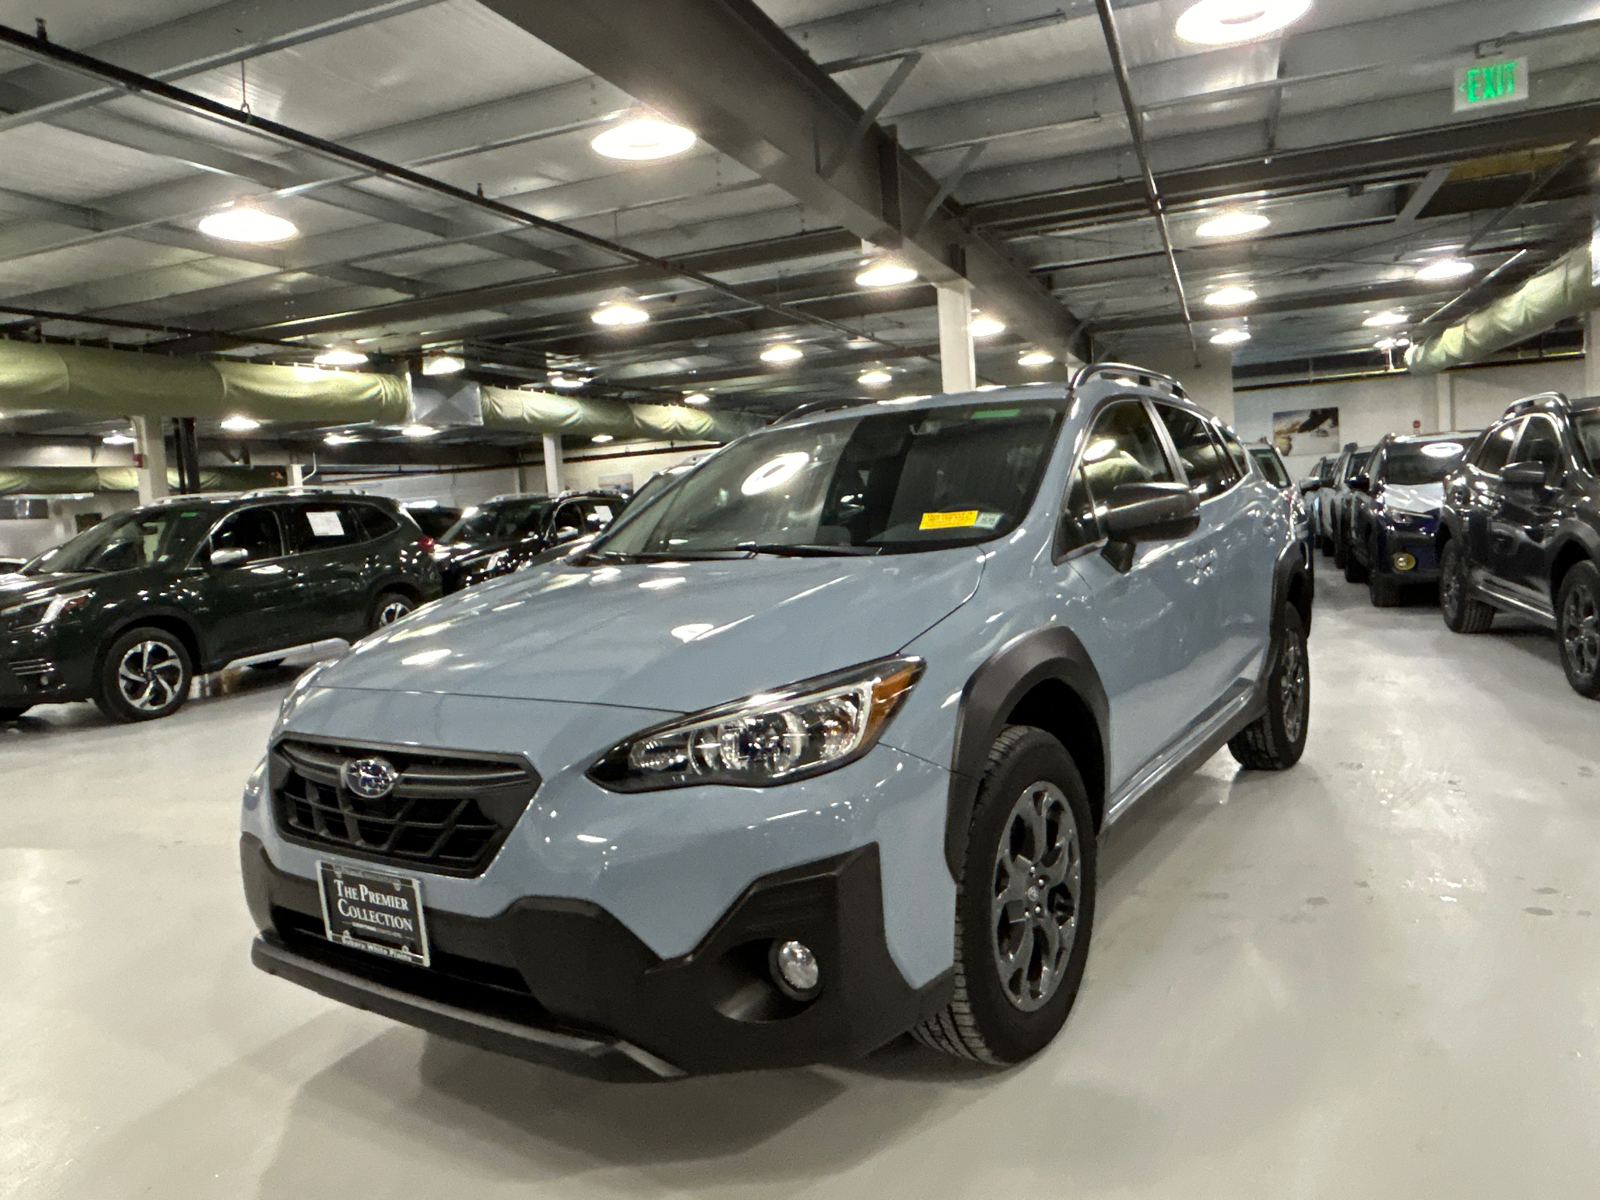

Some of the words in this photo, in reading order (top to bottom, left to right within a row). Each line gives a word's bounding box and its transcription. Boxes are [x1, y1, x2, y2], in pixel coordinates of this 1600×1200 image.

[1467, 61, 1517, 103] EXIT
[333, 879, 359, 901] THE
[358, 883, 410, 912] PREMIER
[337, 898, 413, 932] COLLECTION
